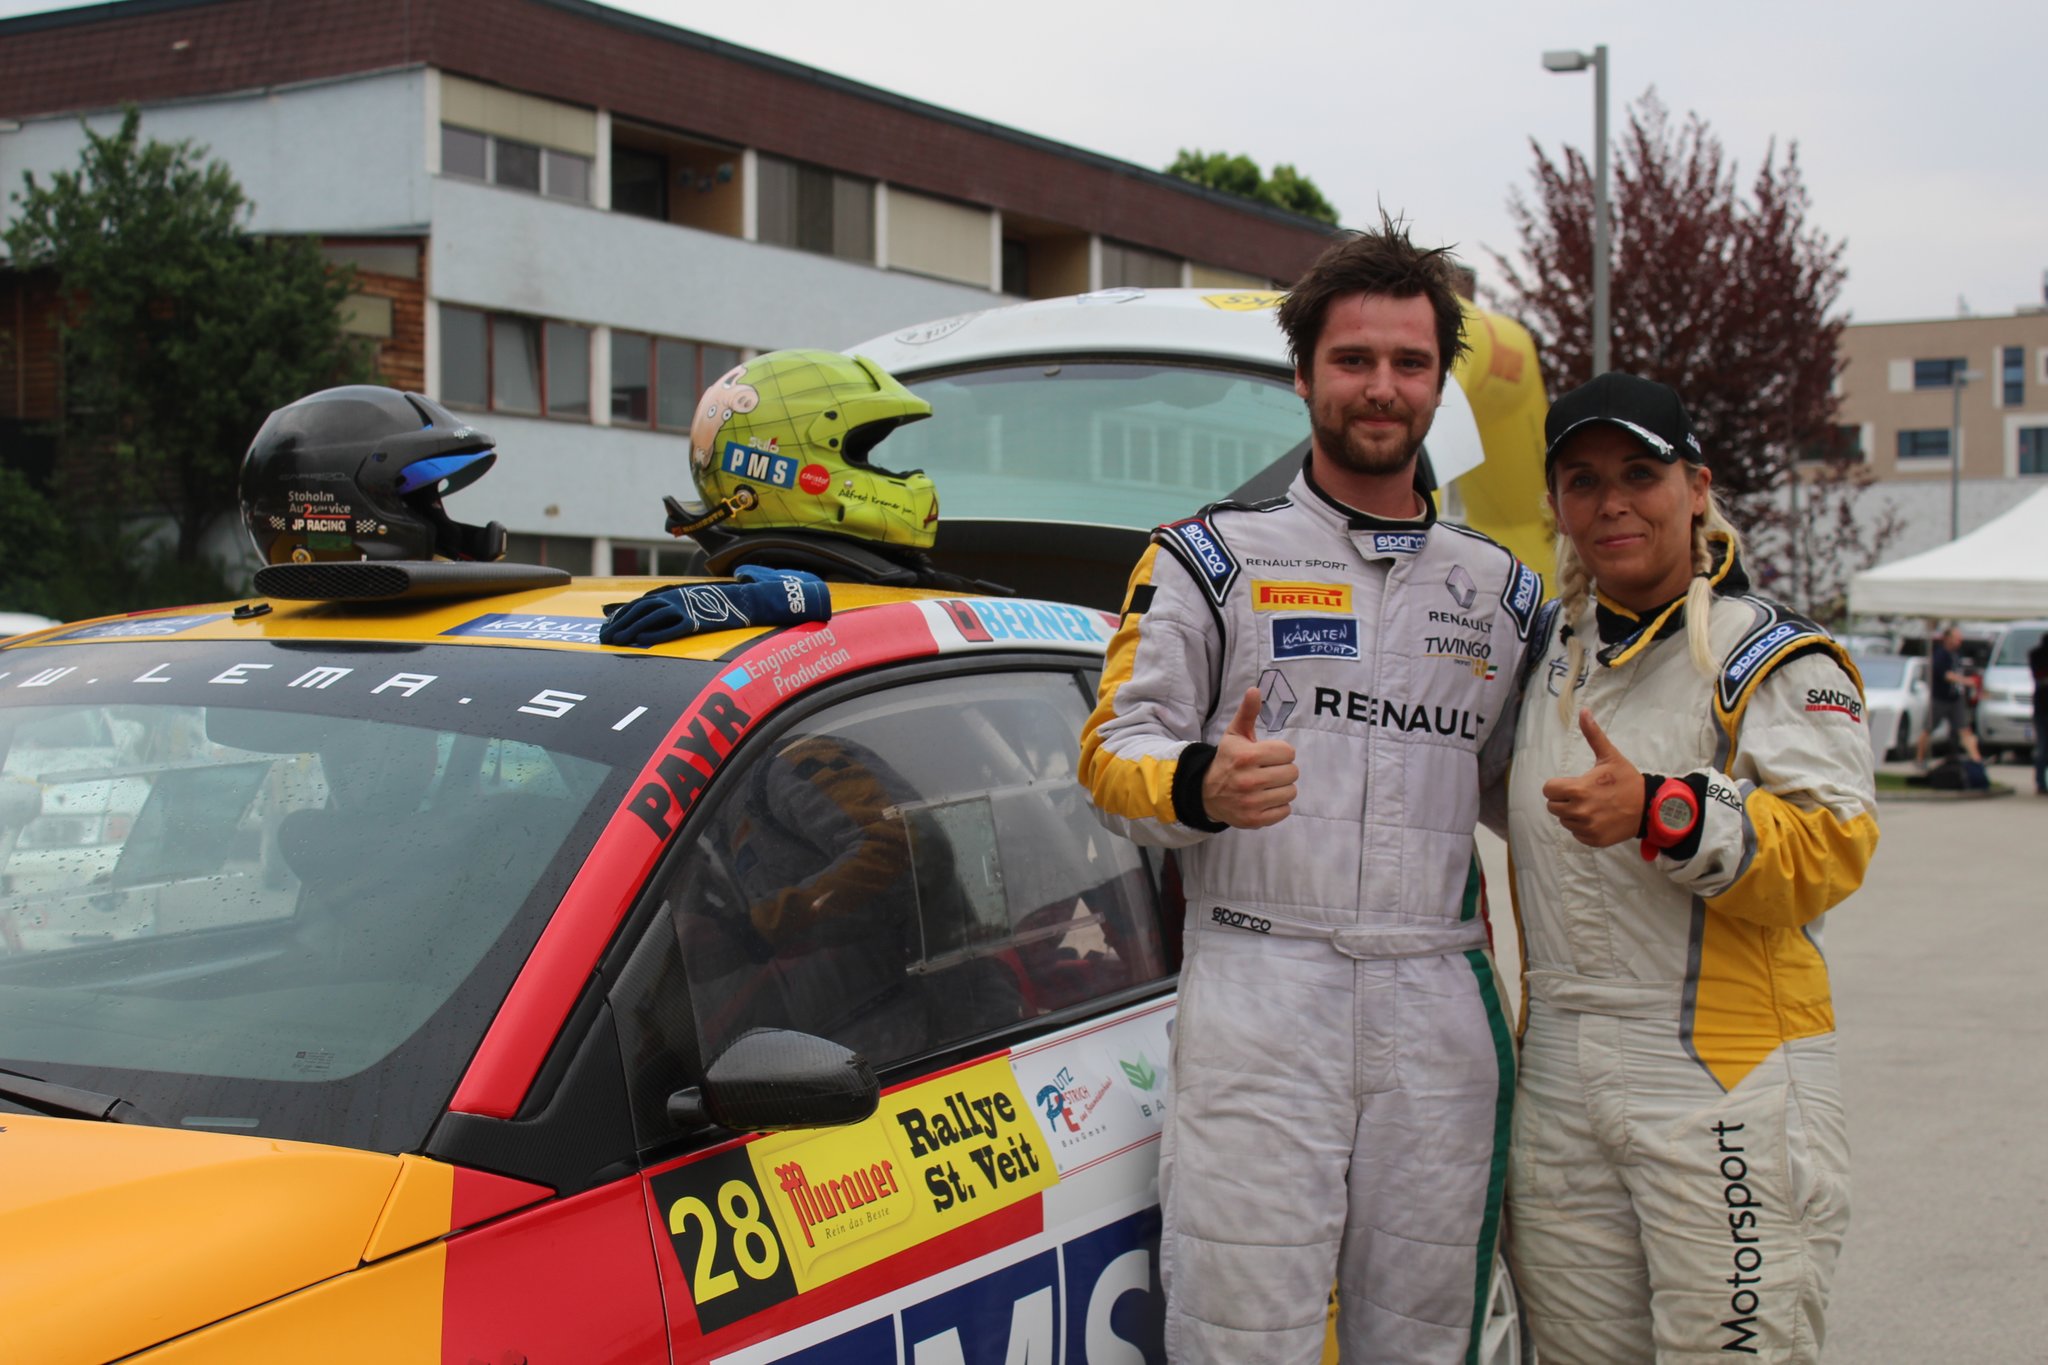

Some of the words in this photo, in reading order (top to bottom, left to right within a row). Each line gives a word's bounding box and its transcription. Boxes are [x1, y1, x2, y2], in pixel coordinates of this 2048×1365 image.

[729, 448, 788, 485] PMS
[288, 490, 335, 502] Stoholm
[292, 518, 305, 531] JP
[306, 519, 347, 532] RACING
[1181, 524, 1227, 577] sparco
[1246, 558, 1302, 568] RENAULT
[1305, 559, 1349, 572] SPORT
[1260, 586, 1343, 607] PIRELLI
[1514, 564, 1535, 614] sparc
[967, 600, 1106, 643] BERNER
[1428, 610, 1494, 634] RENAULT
[743, 627, 837, 680] Engineering
[772, 647, 852, 697] Production
[1424, 637, 1492, 660] TWINGO
[1730, 625, 1796, 681] sparco
[1314, 686, 1485, 740] RENAUL
[626, 691, 751, 842] PAYR
[1211, 906, 1272, 935] sparco
[896, 1091, 1016, 1159] Rallye
[925, 1161, 976, 1213] St.
[968, 1133, 1040, 1190] Veit
[774, 1161, 899, 1249] Murauer
[825, 1223, 846, 1239] Rein
[849, 1218, 864, 1230] das
[866, 1207, 890, 1223] Beste
[669, 1179, 780, 1306] 28
[1710, 1120, 1763, 1355] Motorsport
